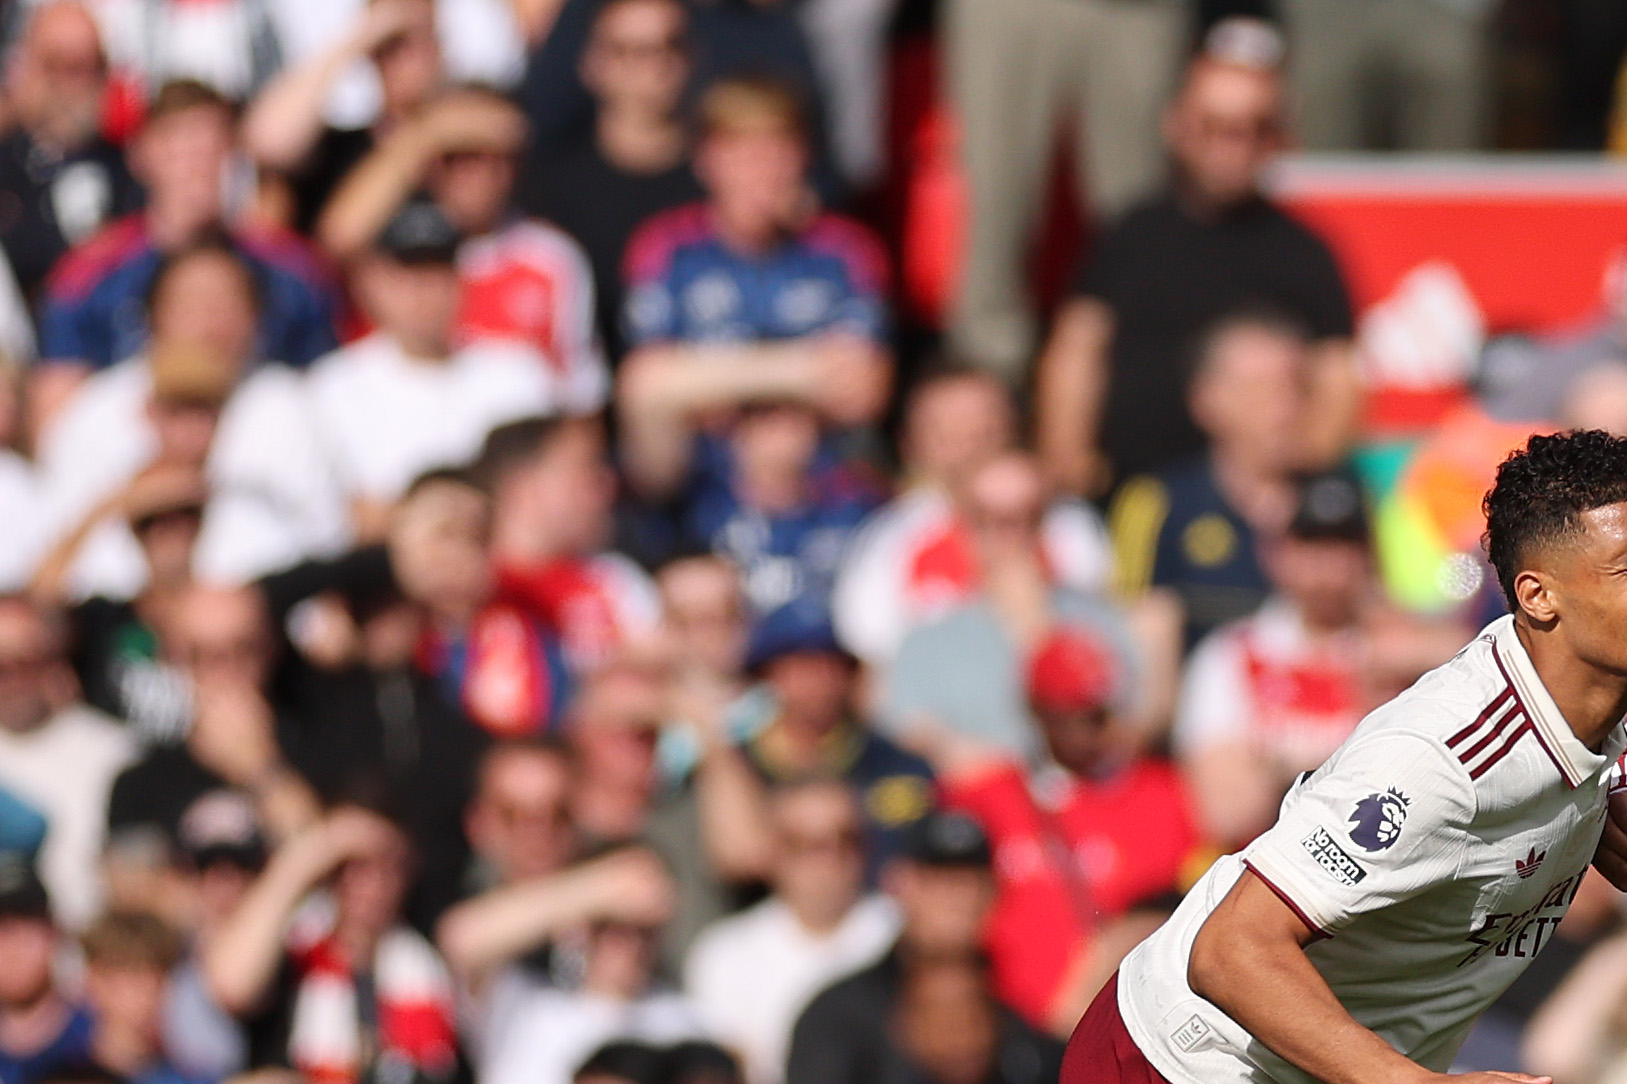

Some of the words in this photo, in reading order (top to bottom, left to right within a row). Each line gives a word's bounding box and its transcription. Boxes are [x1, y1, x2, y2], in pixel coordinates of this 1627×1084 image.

[1309, 826, 1330, 847] No
[1324, 842, 1360, 879] room
[1314, 850, 1357, 888] racism
